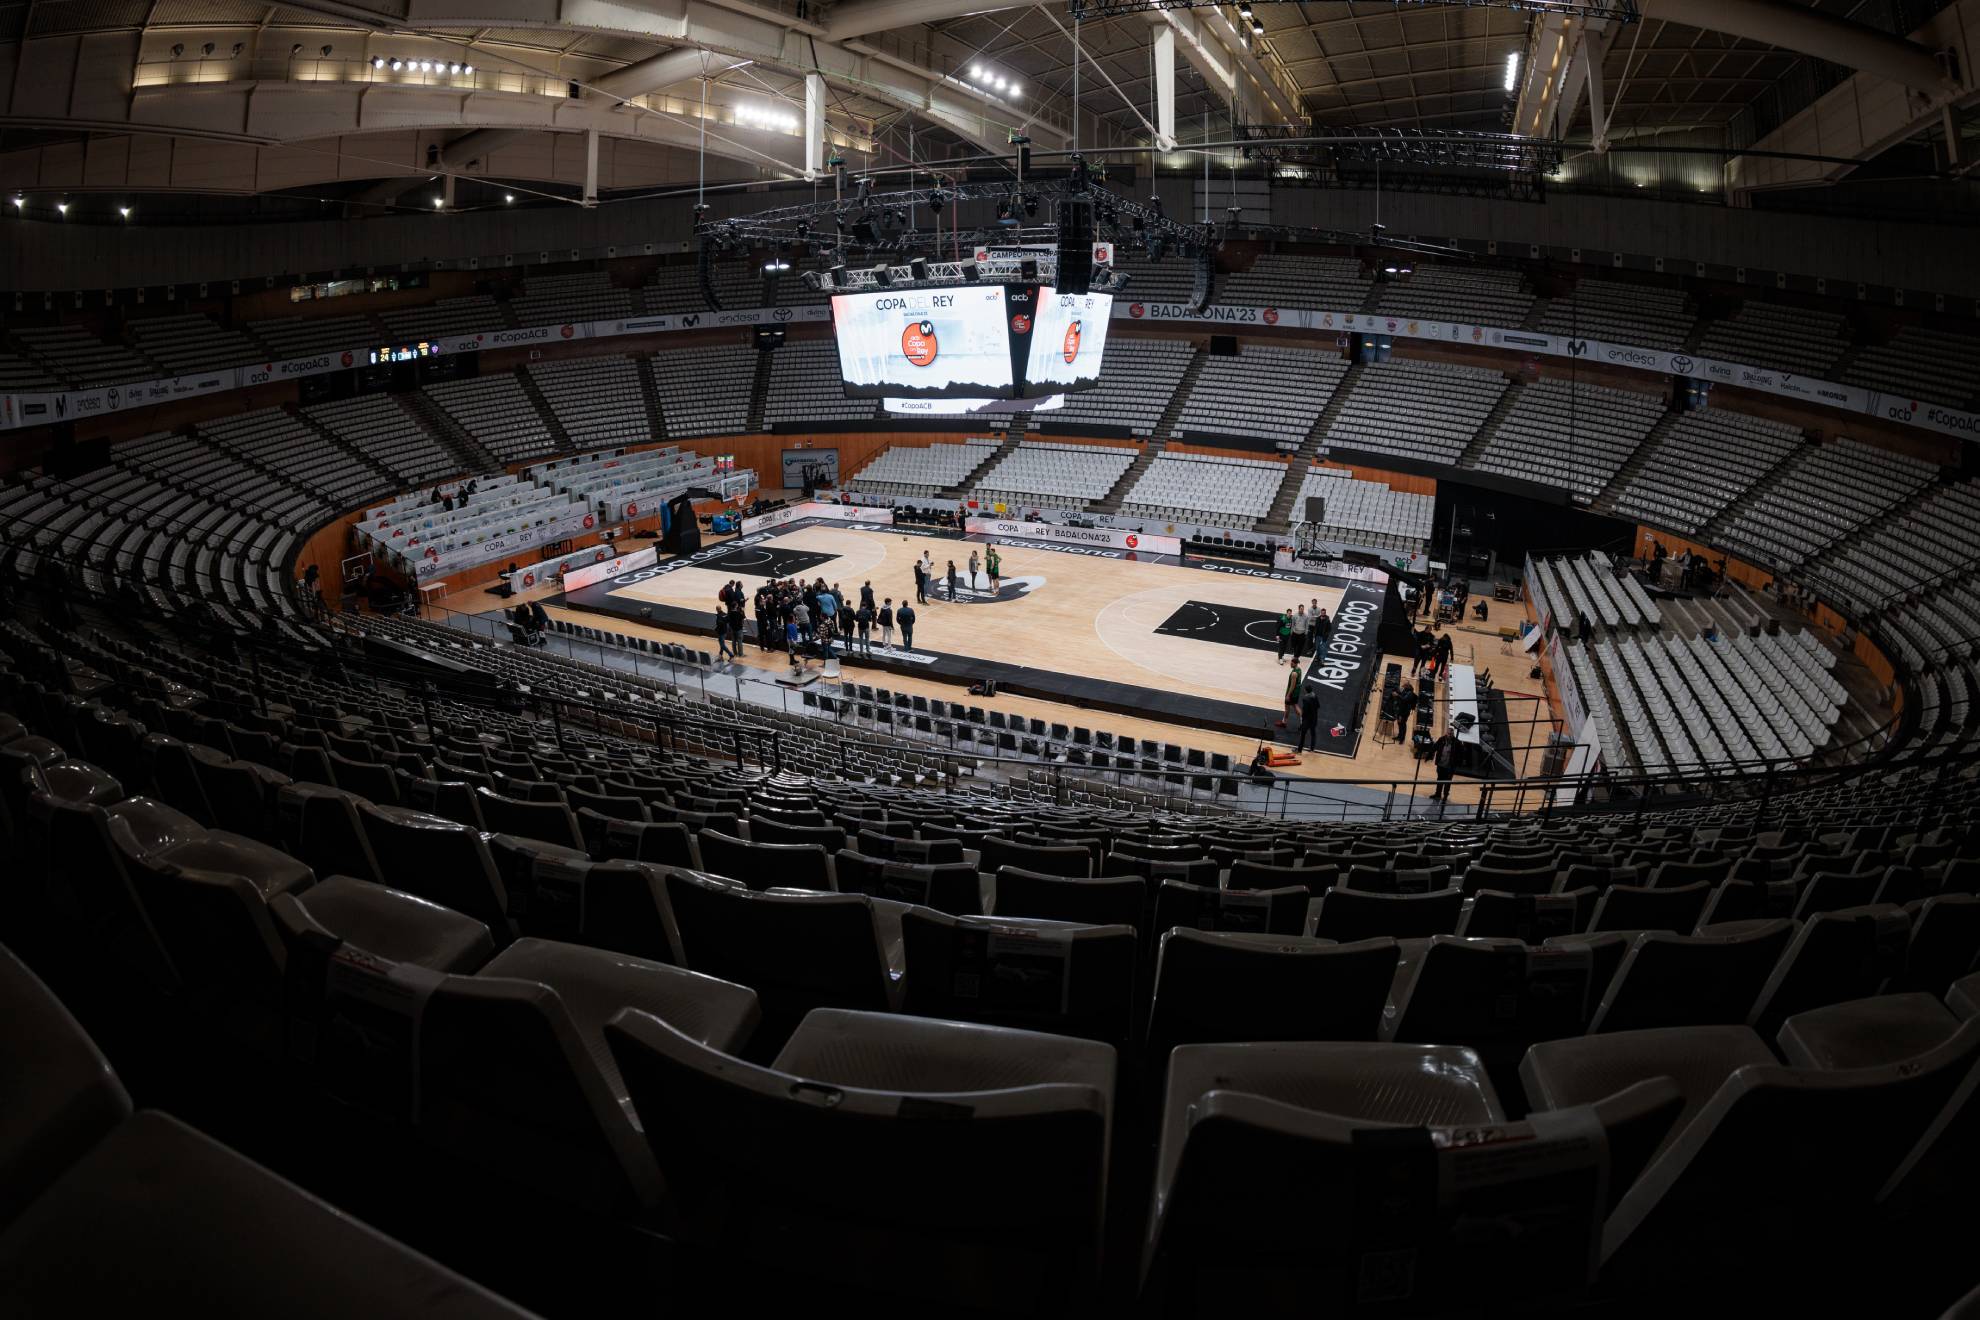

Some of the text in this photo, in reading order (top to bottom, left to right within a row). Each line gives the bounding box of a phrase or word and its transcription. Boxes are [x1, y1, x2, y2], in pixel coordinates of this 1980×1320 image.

[876, 298, 907, 310] COPA
[932, 295, 954, 308] REY
[1060, 296, 1075, 307] COPA
[719, 313, 760, 323] endesa
[459, 328, 548, 350] acb #CopaACB
[1608, 349, 1656, 367] endesa
[251, 357, 330, 384] acb #CopaACB
[901, 402, 932, 410] #CopaACB
[1889, 406, 1911, 421] acb
[758, 515, 773, 525] COPA
[783, 510, 793, 518] REY
[1060, 511, 1115, 524] COPA REY
[998, 523, 1018, 532] COPA
[1035, 527, 1050, 537] REY
[1055, 530, 1111, 543] BADALONA'23
[484, 541, 505, 552] COPA
[519, 533, 532, 543] REY
[614, 533, 777, 584] Copa del Rey
[419, 563, 436, 576] acb
[607, 566, 618, 574] acb
[1201, 563, 1301, 582] endesa
[1303, 559, 1327, 569] COPA
[1347, 563, 1365, 574] REY
[1307, 600, 1378, 691] Copa del Rey
